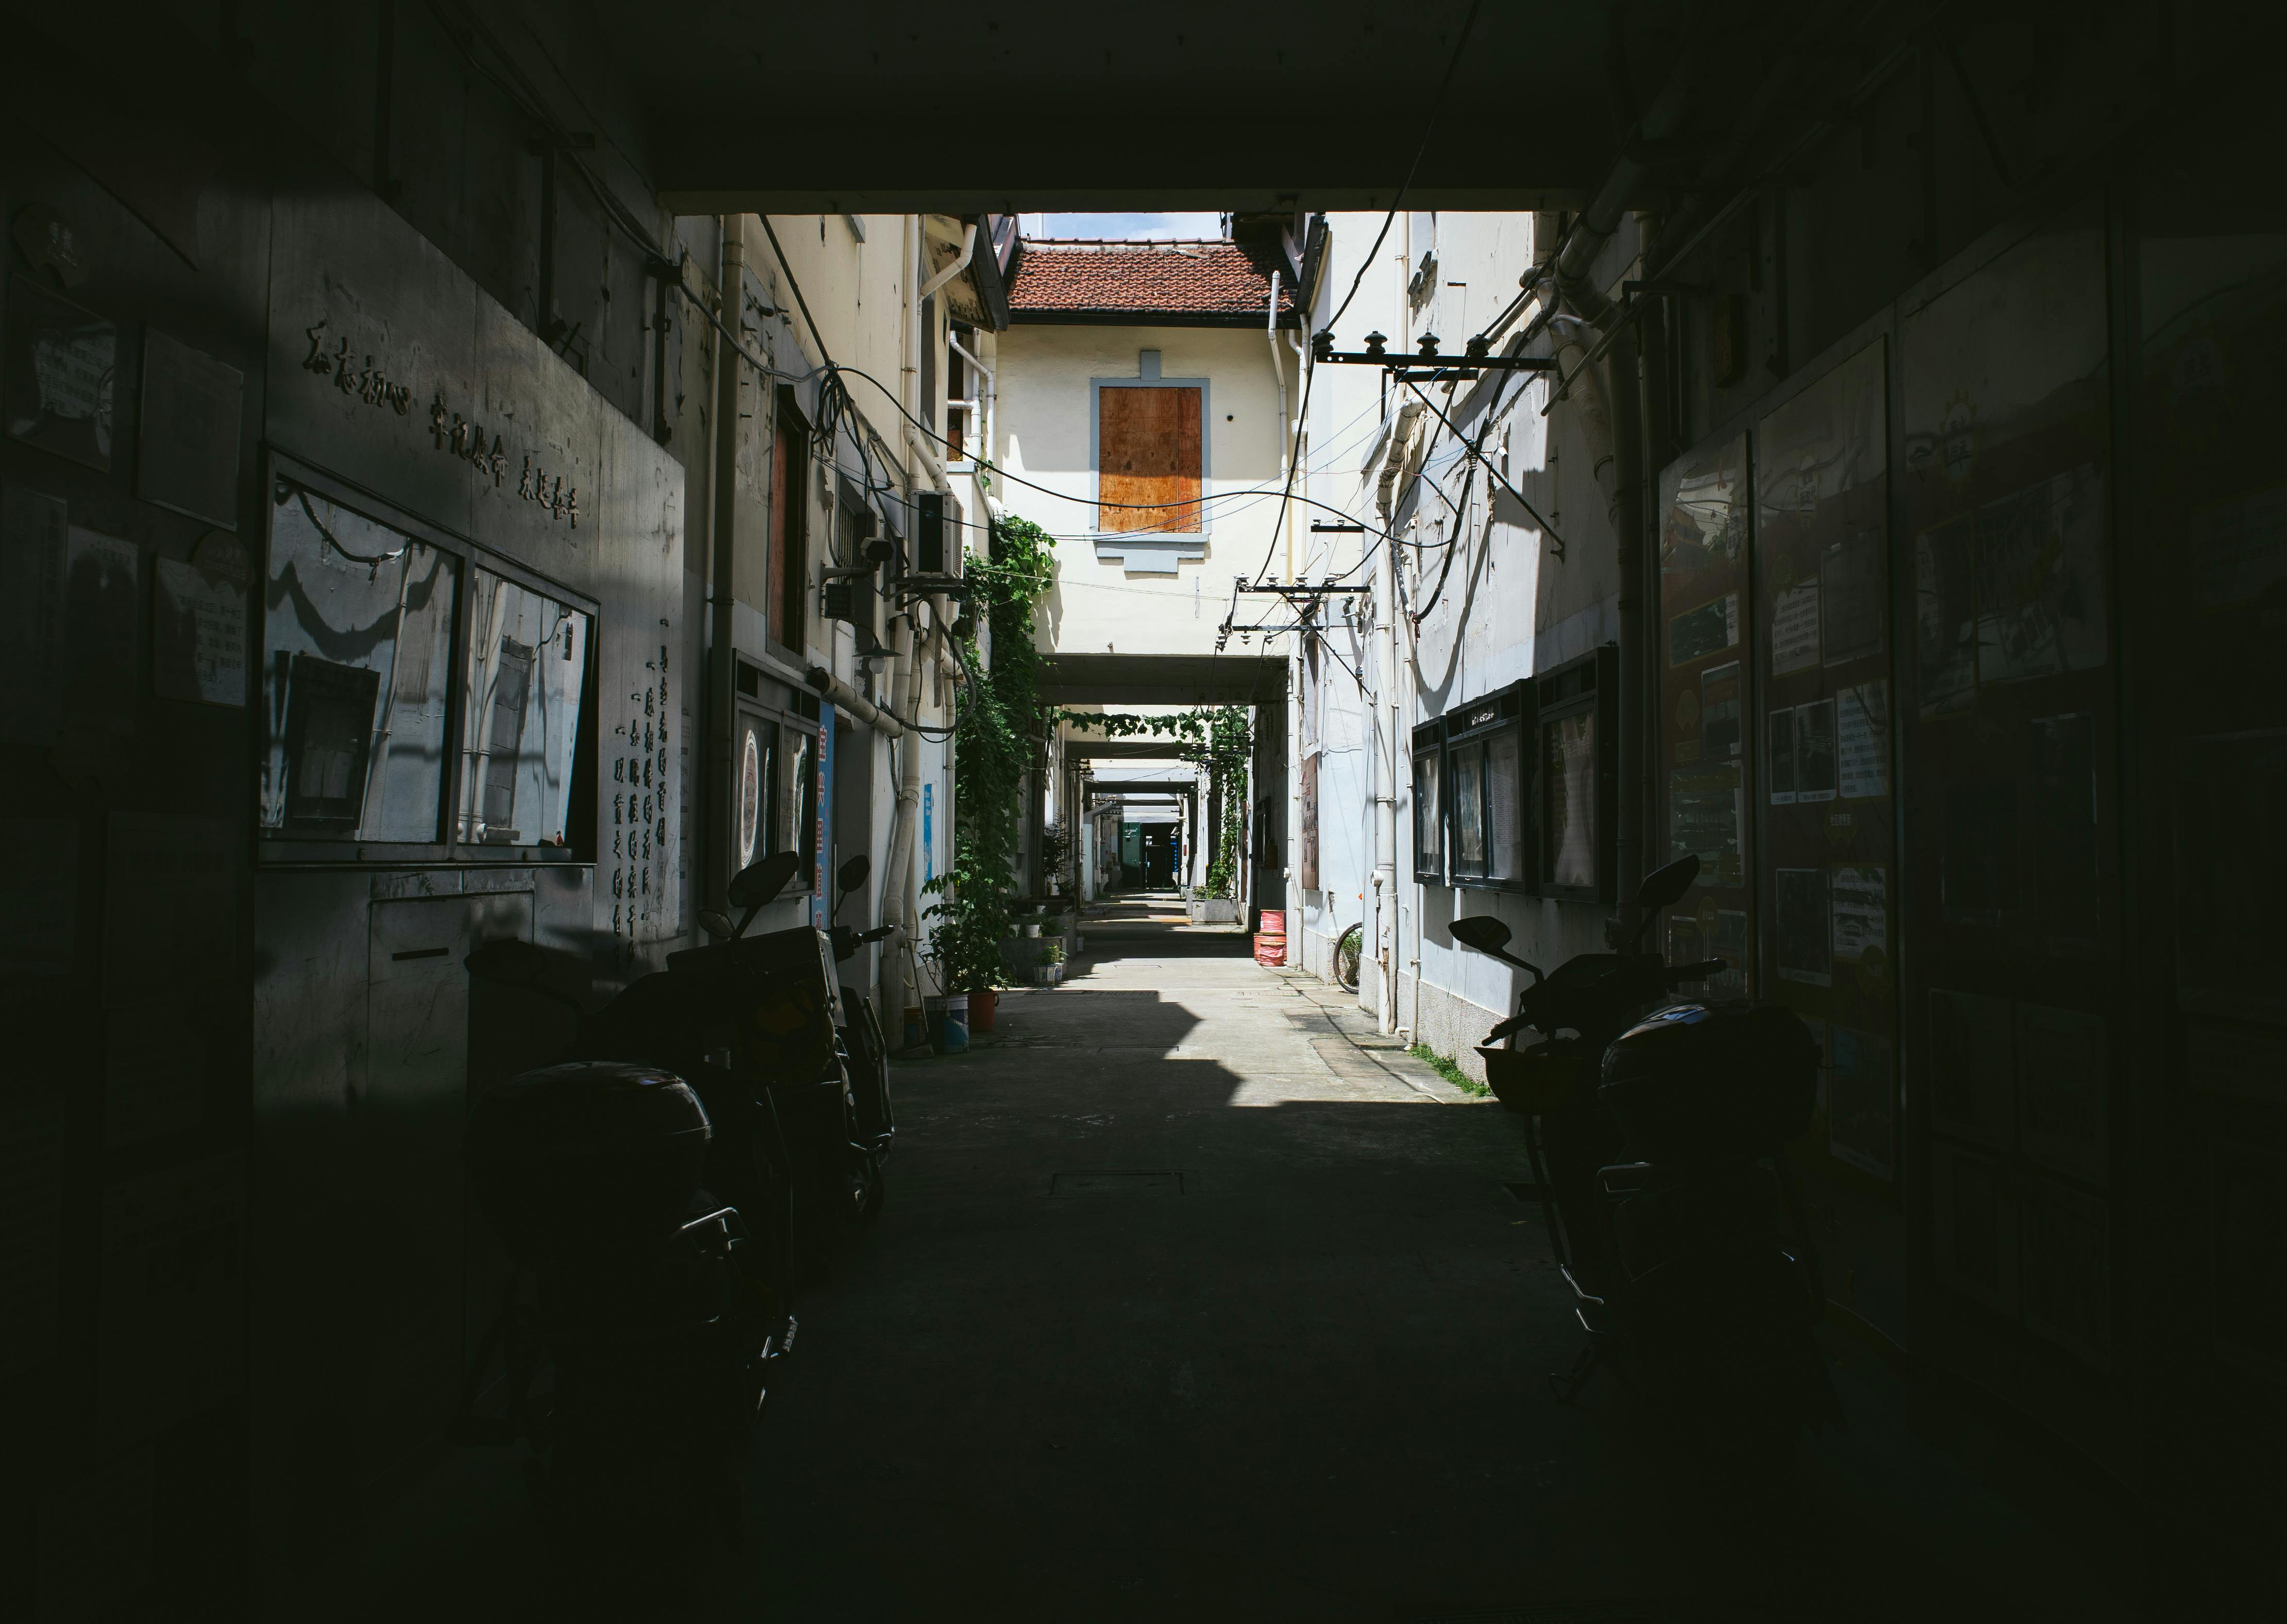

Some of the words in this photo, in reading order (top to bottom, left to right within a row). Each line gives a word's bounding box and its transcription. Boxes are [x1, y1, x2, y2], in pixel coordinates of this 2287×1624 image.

[302, 320, 411, 416] 不忘初心
[429, 394, 509, 488] 牢记使命
